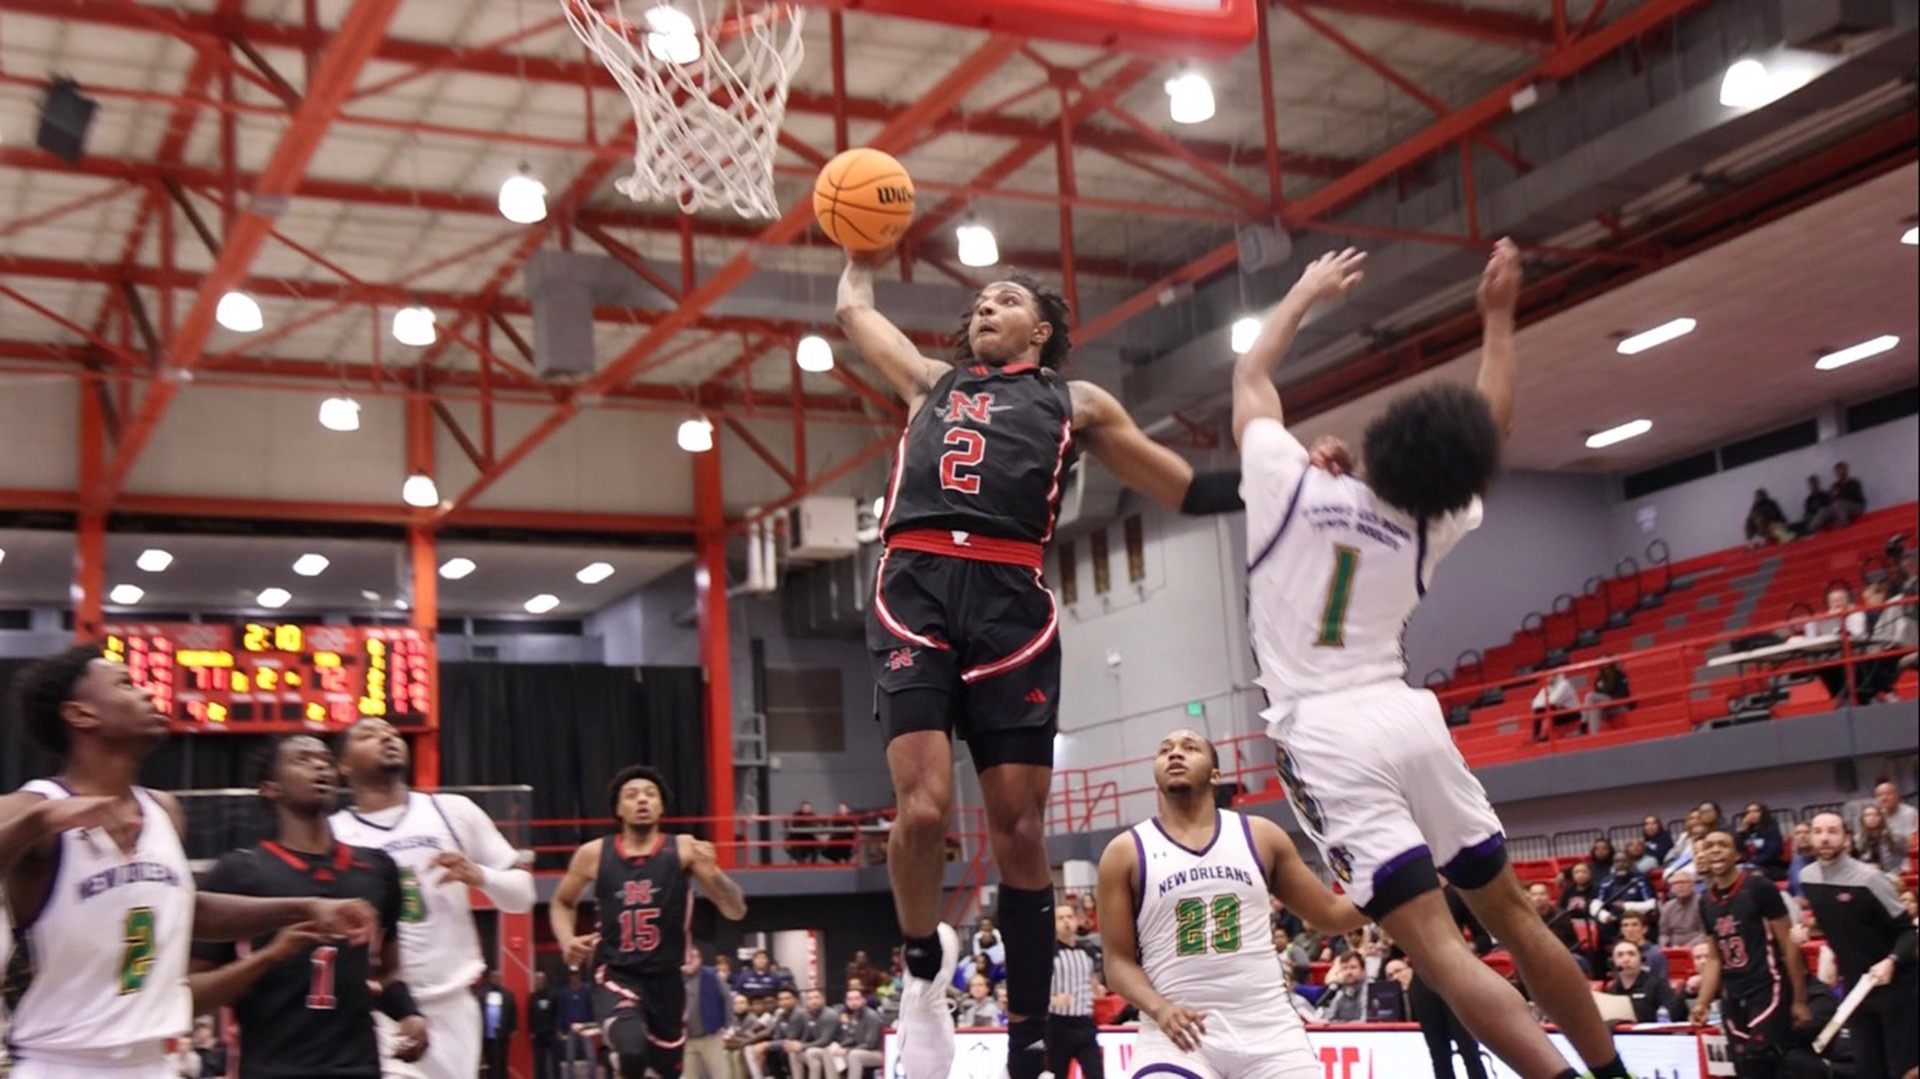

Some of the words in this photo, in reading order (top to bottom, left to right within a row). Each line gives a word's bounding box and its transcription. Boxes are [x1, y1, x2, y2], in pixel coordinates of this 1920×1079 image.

[944, 389, 995, 425] N
[939, 427, 986, 494] 2
[1312, 542, 1362, 649] 1
[243, 624, 302, 651] 2:10
[1158, 870, 1187, 898] NEW
[1189, 865, 1253, 887] ORLEANS
[118, 906, 157, 996] 2
[618, 907, 661, 952] 15
[1175, 892, 1241, 957] 23
[305, 945, 339, 1009] 1
[1719, 936, 1748, 969] 13
